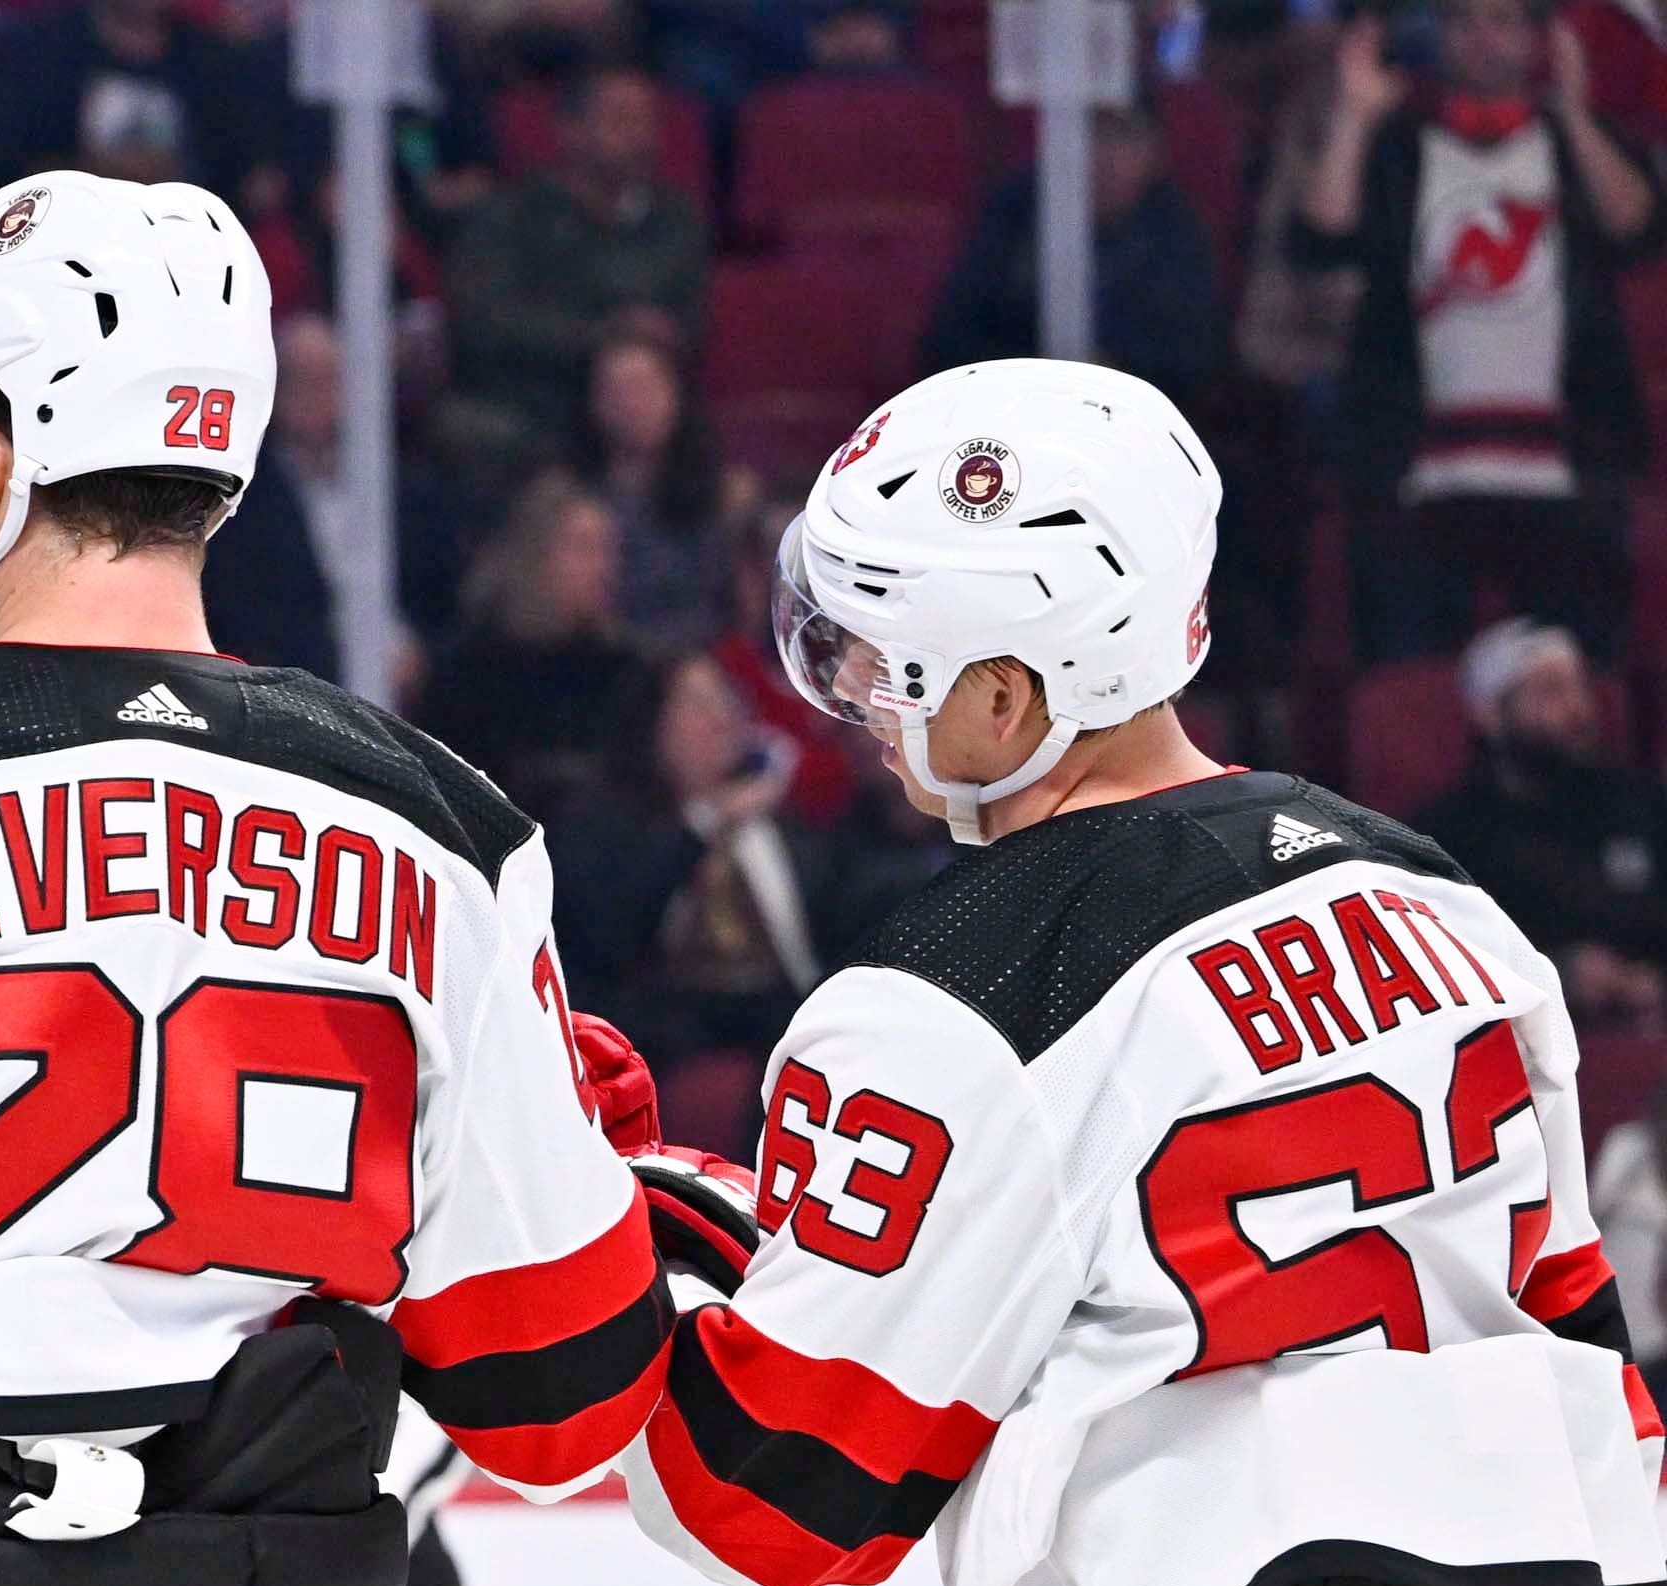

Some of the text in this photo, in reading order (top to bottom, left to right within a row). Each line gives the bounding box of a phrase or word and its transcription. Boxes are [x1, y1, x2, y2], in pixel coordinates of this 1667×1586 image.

[164, 385, 235, 451] 28
[943, 487, 1014, 519] COFFEE HOUSE
[874, 693, 918, 708] BAUER
[1272, 831, 1343, 862] adidas
[1187, 889, 1507, 1075] BRATT
[755, 1055, 954, 1277] 63
